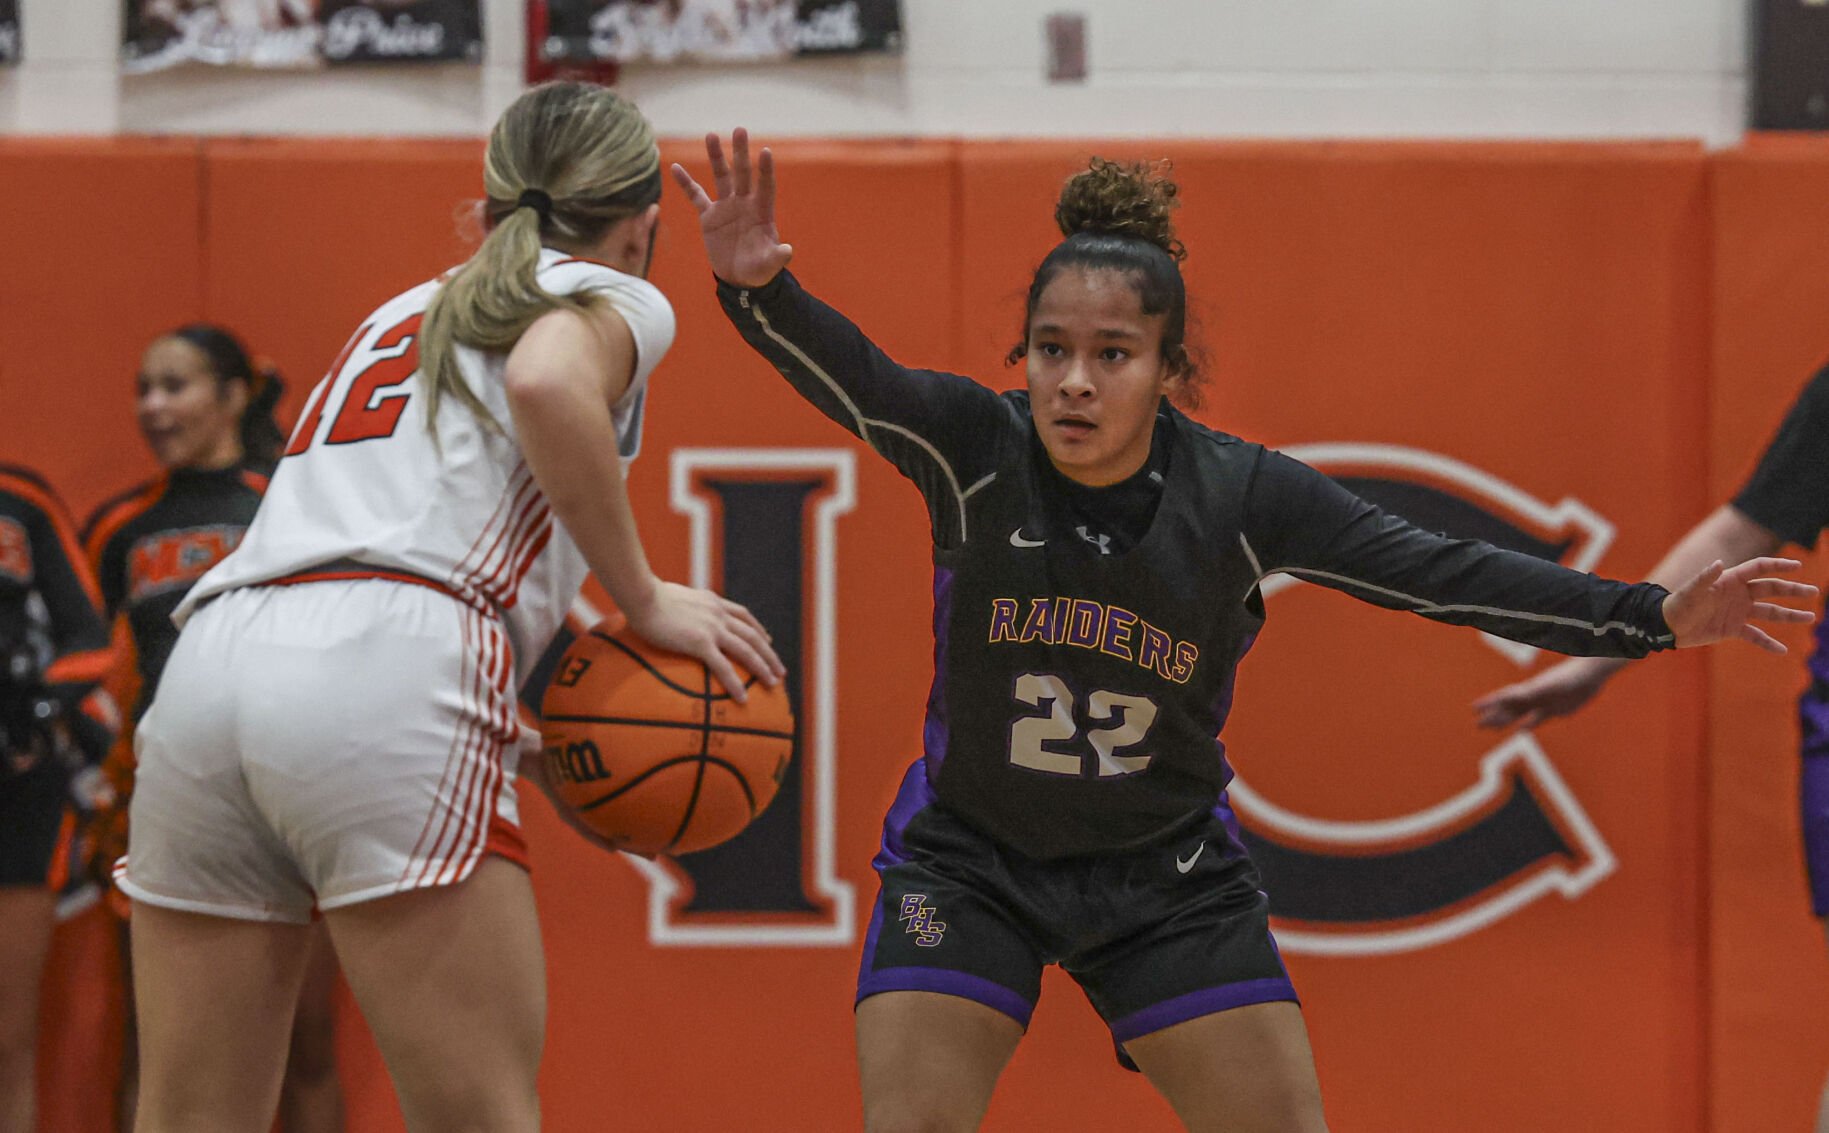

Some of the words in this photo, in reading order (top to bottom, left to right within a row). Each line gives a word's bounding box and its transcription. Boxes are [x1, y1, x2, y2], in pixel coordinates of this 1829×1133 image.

[988, 596, 1199, 685] RAIDERS
[1009, 672, 1158, 777] 22
[899, 893, 946, 947] BHS
